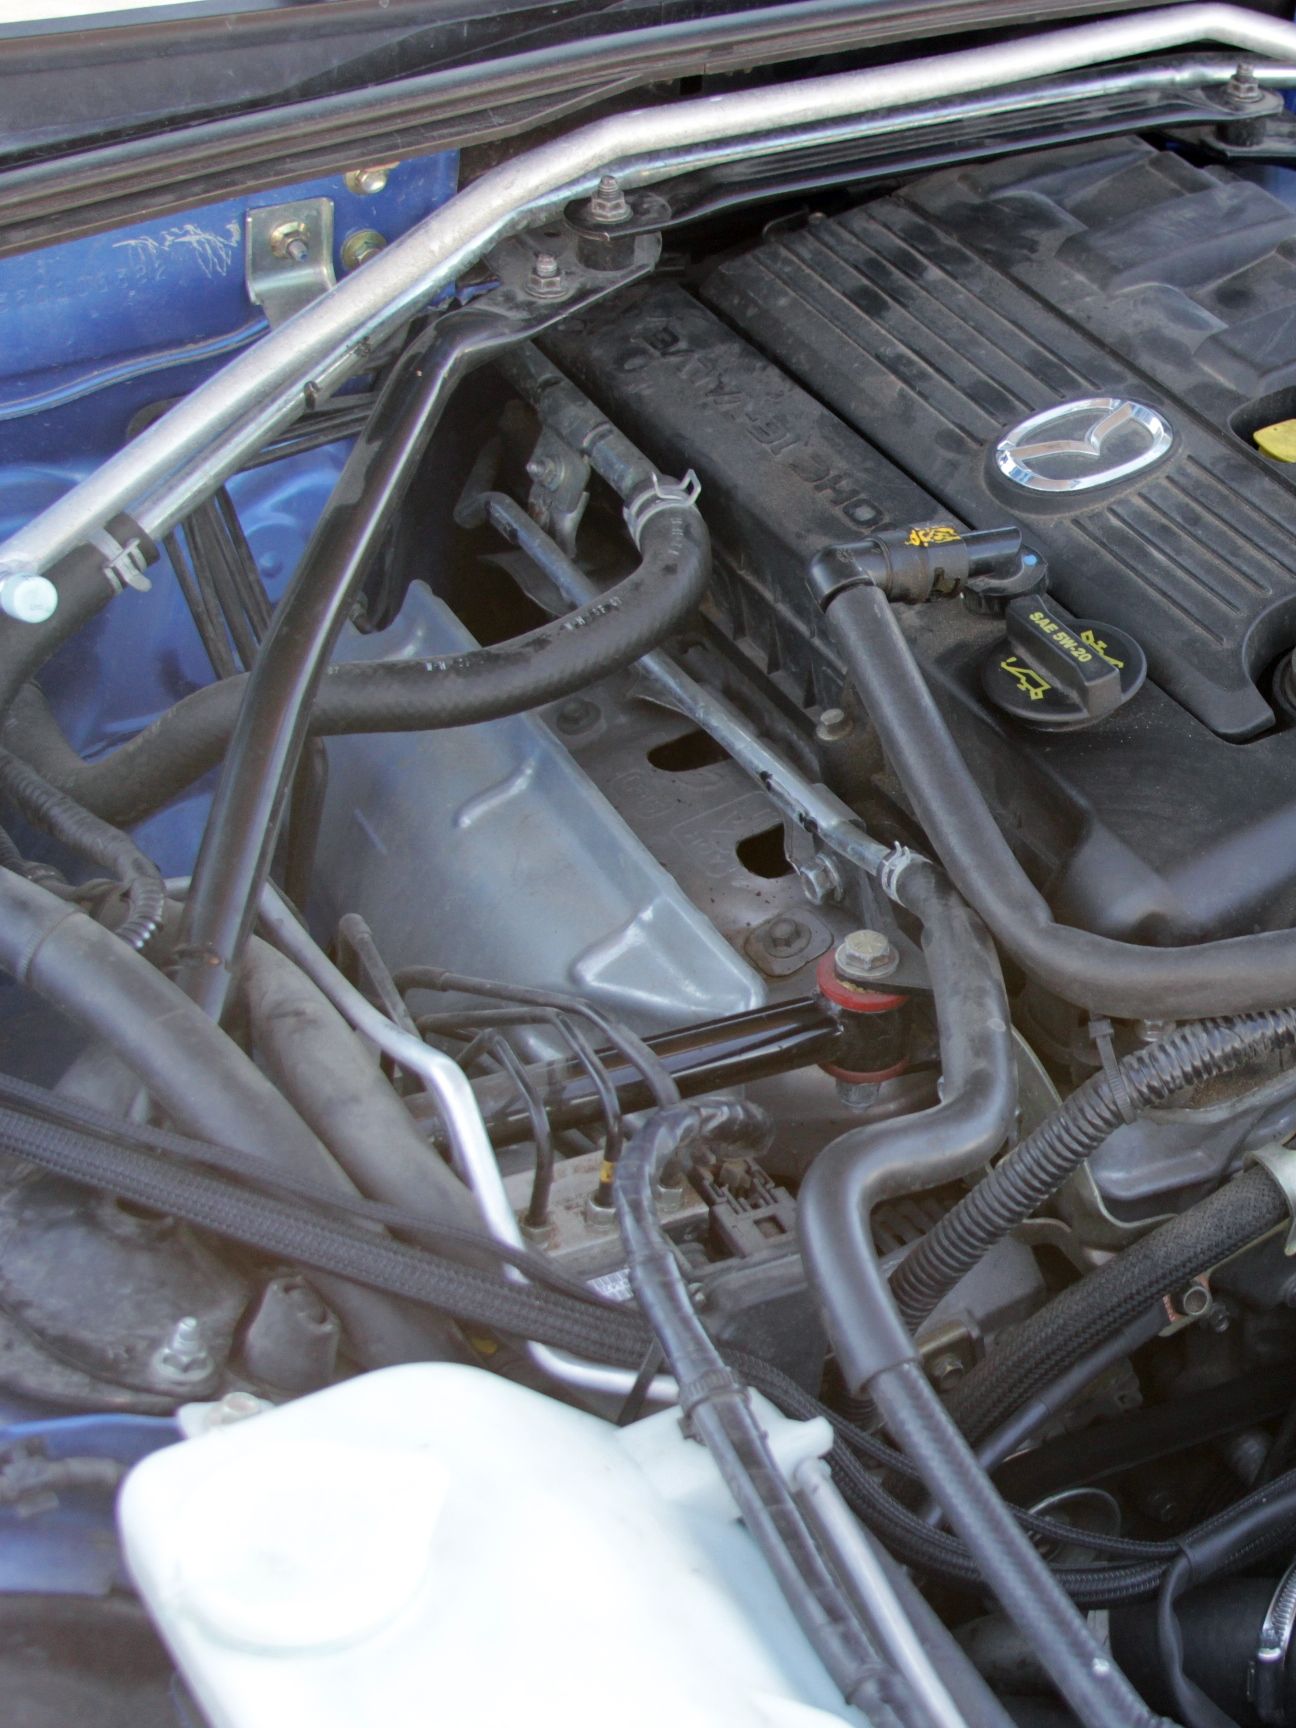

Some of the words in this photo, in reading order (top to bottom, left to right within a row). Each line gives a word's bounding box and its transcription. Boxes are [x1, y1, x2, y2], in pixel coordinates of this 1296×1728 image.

[790, 452, 895, 534] OHC
[1029, 611, 1056, 634] SAE
[1053, 631, 1093, 663] 5W-20
